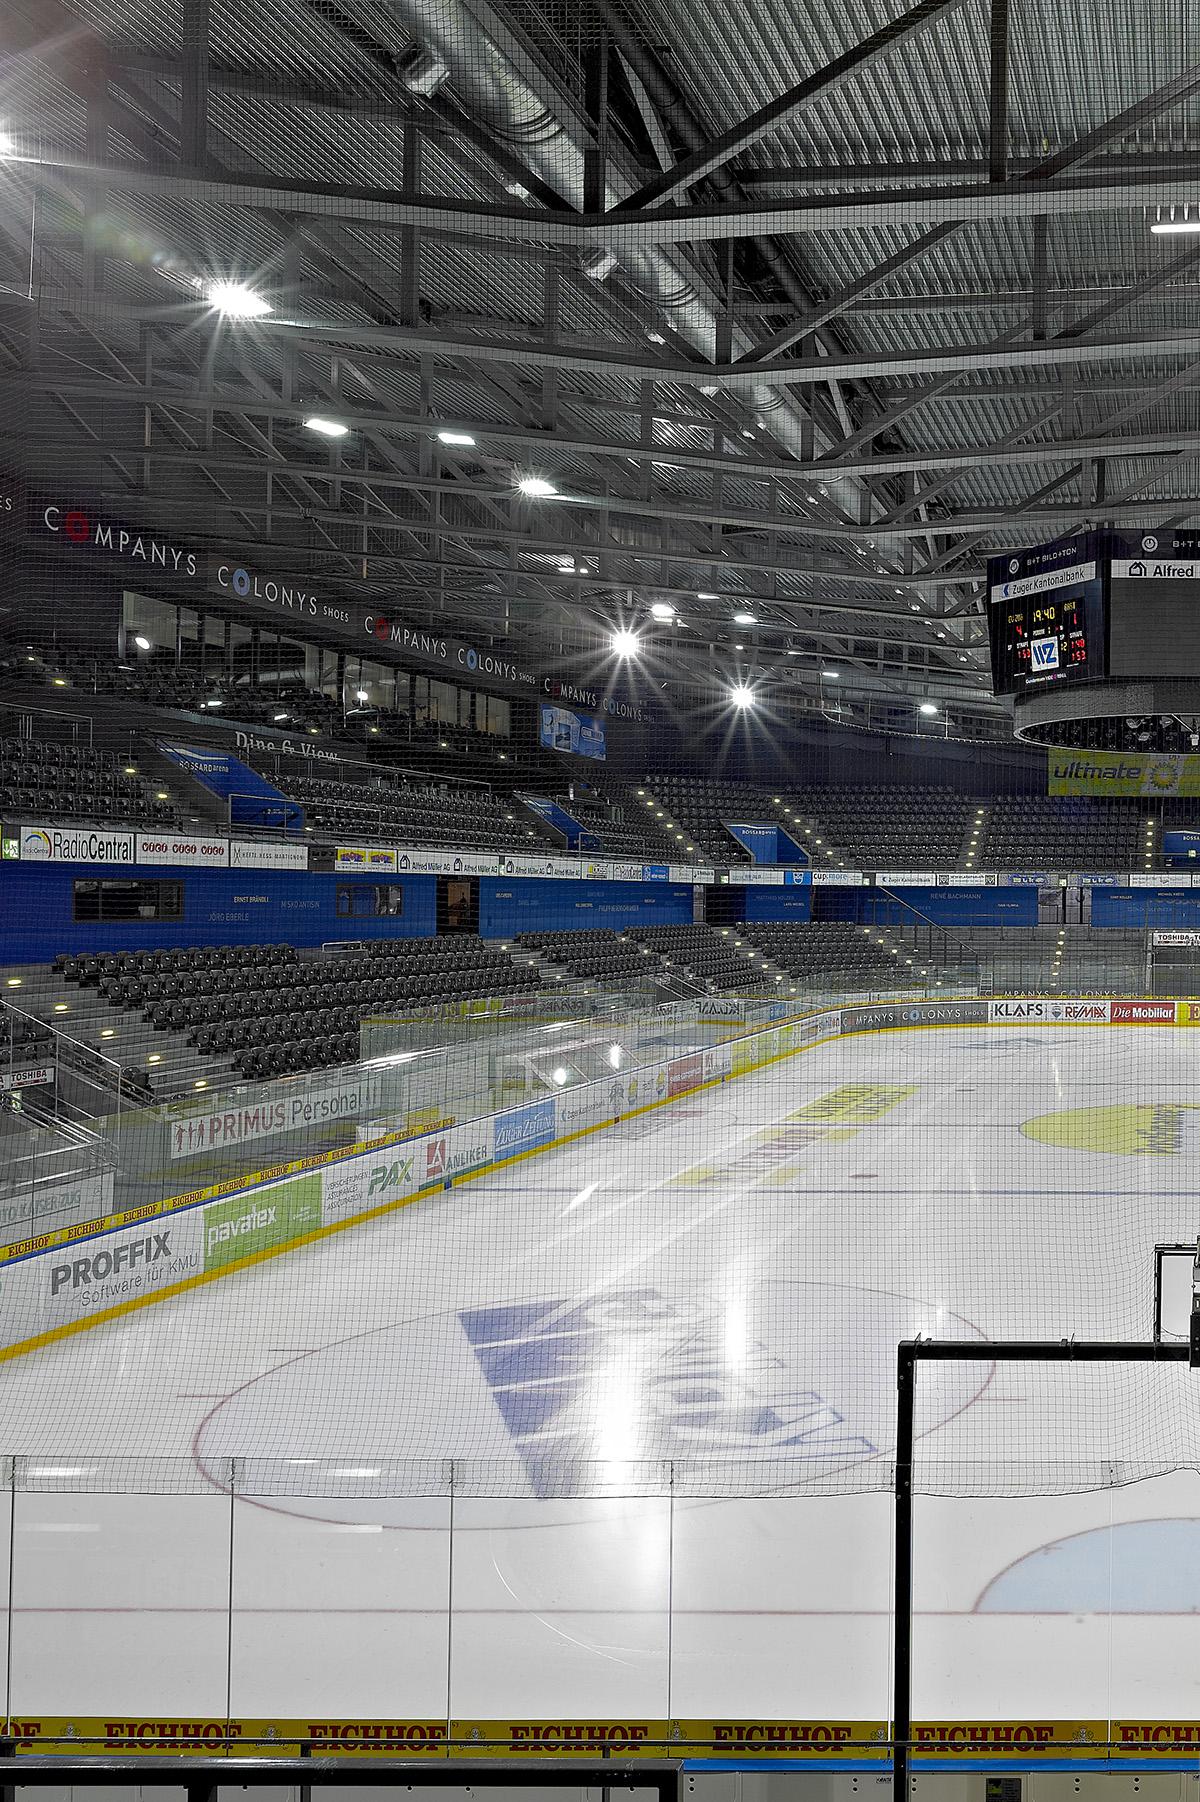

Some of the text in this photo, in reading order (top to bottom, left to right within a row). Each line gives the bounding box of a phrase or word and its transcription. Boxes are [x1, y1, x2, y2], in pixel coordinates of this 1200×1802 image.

[44, 506, 197, 576] COMPANYS
[1012, 569, 1085, 598] Zuger Kantonalbank
[1153, 564, 1194, 578] Alfred
[217, 566, 349, 622] COLONYS SHOES
[364, 616, 447, 658] COMPANYS
[457, 649, 517, 681] COLONYS
[603, 699, 642, 722] COLONYS
[1054, 762, 1141, 780] ultimate
[54, 831, 132, 861] RadioCentral
[412, 862, 427, 870] Alfred
[902, 1008, 961, 1021] COLONYS
[994, 1003, 1043, 1017] KLAFS
[1065, 1005, 1107, 1019] RE/MAX
[1112, 1005, 1173, 1019] Die Mobiliar
[11, 1070, 47, 1082] TOSHIBA
[209, 1089, 363, 1144] PRIMUS Personal
[301, 1153, 329, 1169] EICHHOF
[446, 1144, 488, 1172] ANLIKER
[218, 1177, 247, 1194] EICHHOF
[260, 1164, 290, 1181] EICHHOF
[368, 1156, 416, 1196] PAX
[172, 1190, 204, 1208] EICHHOF
[123, 1204, 158, 1223] EICHHOF
[68, 1219, 106, 1239] EICHHOF
[207, 1204, 277, 1257] pavatex
[8, 1236, 50, 1258] EICHHOF
[51, 1230, 172, 1296] PROFFIX
[81, 1252, 199, 1308] Software für KMU
[104, 1723, 242, 1749] EICHHOF
[308, 1725, 447, 1751] EICHHOF
[509, 1726, 648, 1752] EICHHOF
[713, 1725, 852, 1752] EICHHOF
[915, 1726, 1054, 1752] EICHHOF
